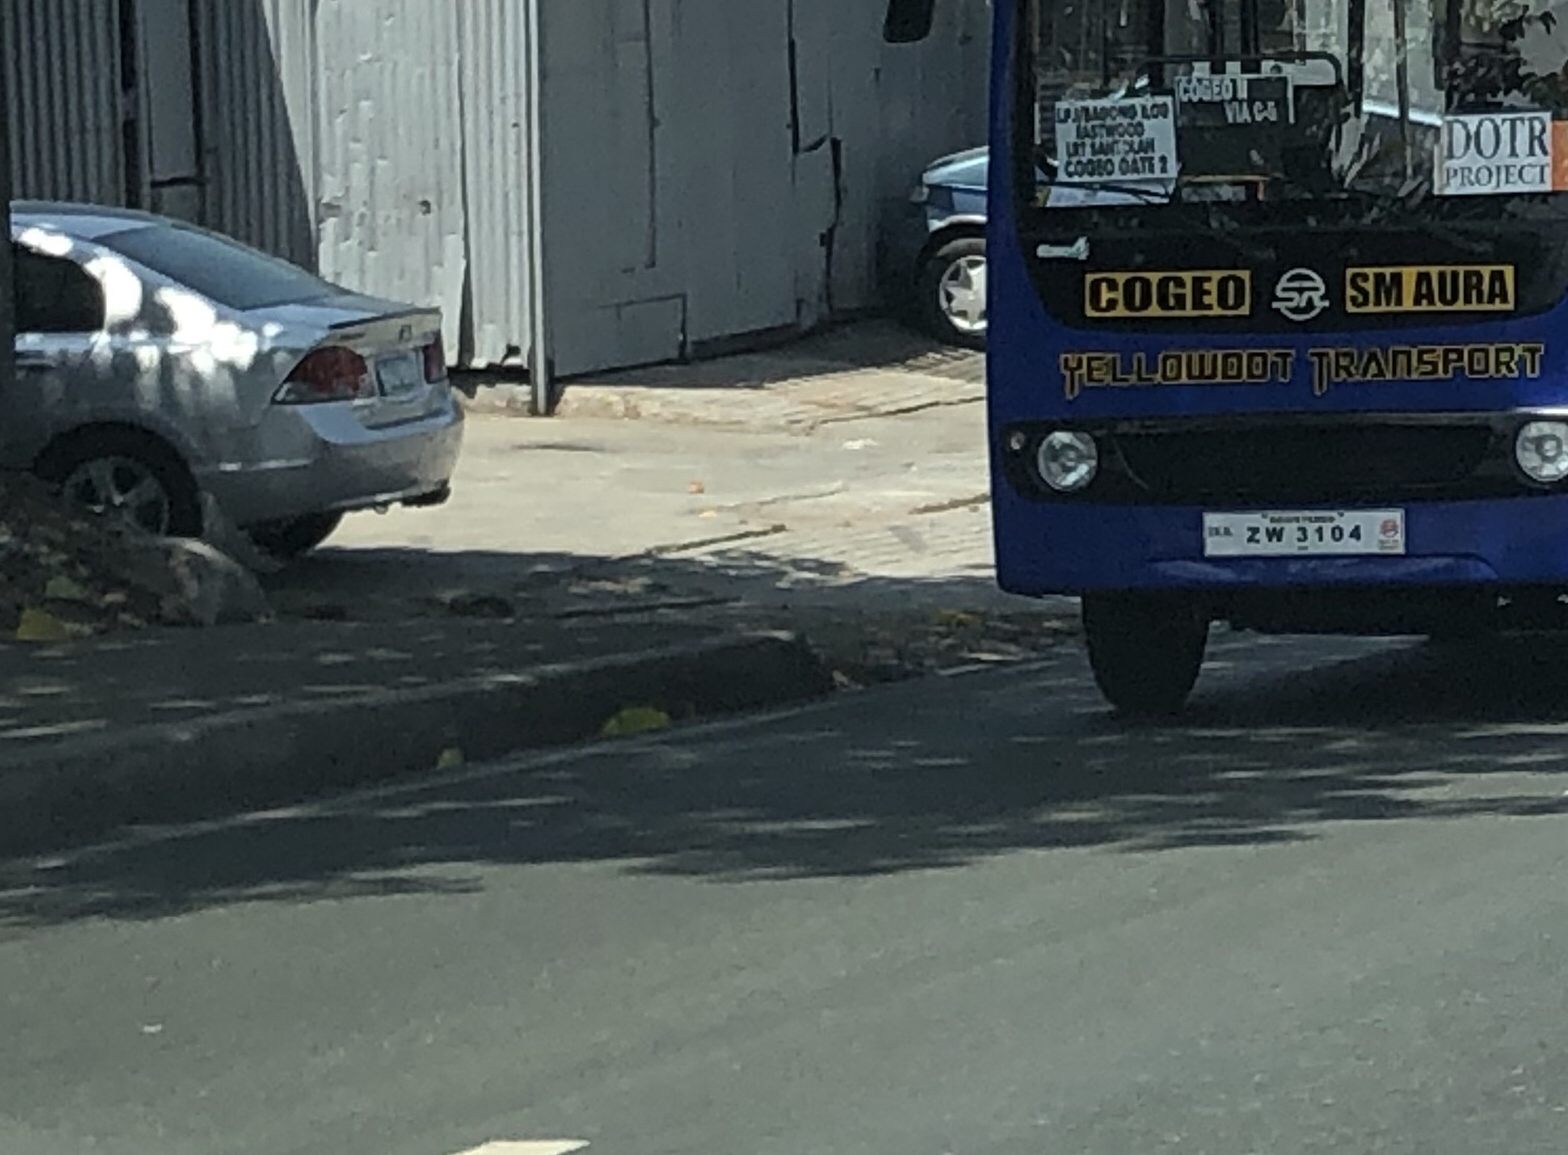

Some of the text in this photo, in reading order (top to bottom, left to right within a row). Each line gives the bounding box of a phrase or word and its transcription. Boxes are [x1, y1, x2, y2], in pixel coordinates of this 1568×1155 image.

[1444, 115, 1549, 160] DOTR
[1445, 163, 1549, 189] PROJECT
[1088, 273, 1246, 313] COGEO
[1349, 269, 1511, 308] SM AURA
[1060, 343, 1545, 400] YELLOWDOT TRANSPORT
[1246, 526, 1285, 544] ZW
[1296, 525, 1362, 543] 3104
